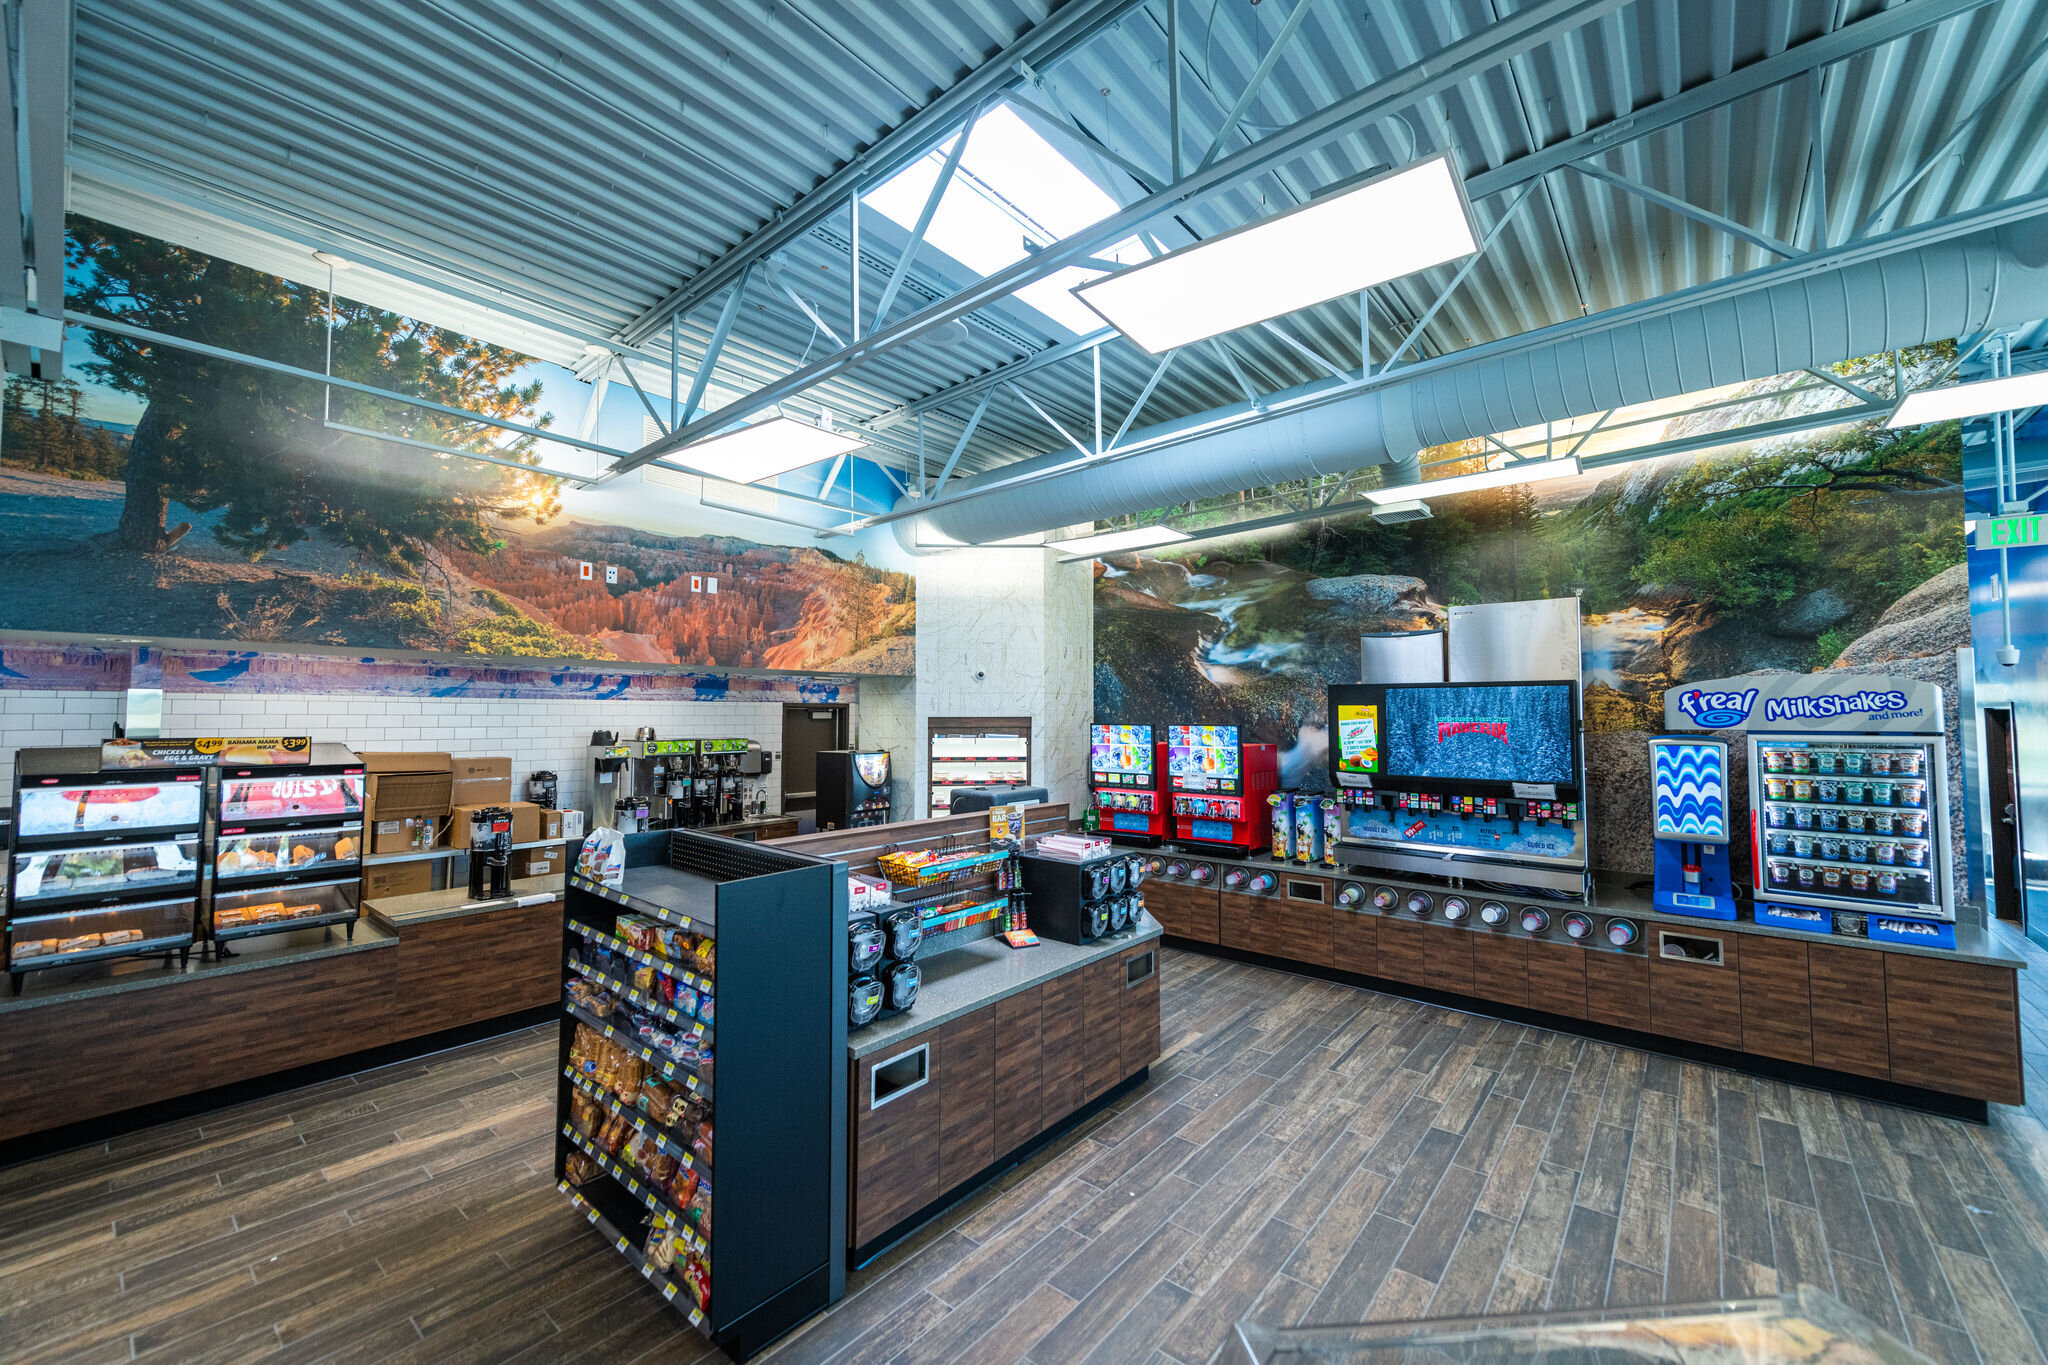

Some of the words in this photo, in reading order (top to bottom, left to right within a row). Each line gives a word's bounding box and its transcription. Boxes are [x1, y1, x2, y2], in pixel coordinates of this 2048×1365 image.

[1991, 516, 2042, 546] EXIT
[1868, 711, 1890, 721] and
[1891, 708, 1923, 720] more!
[1438, 722, 1509, 745] MAVERIK
[992, 814, 1007, 822] BAR
